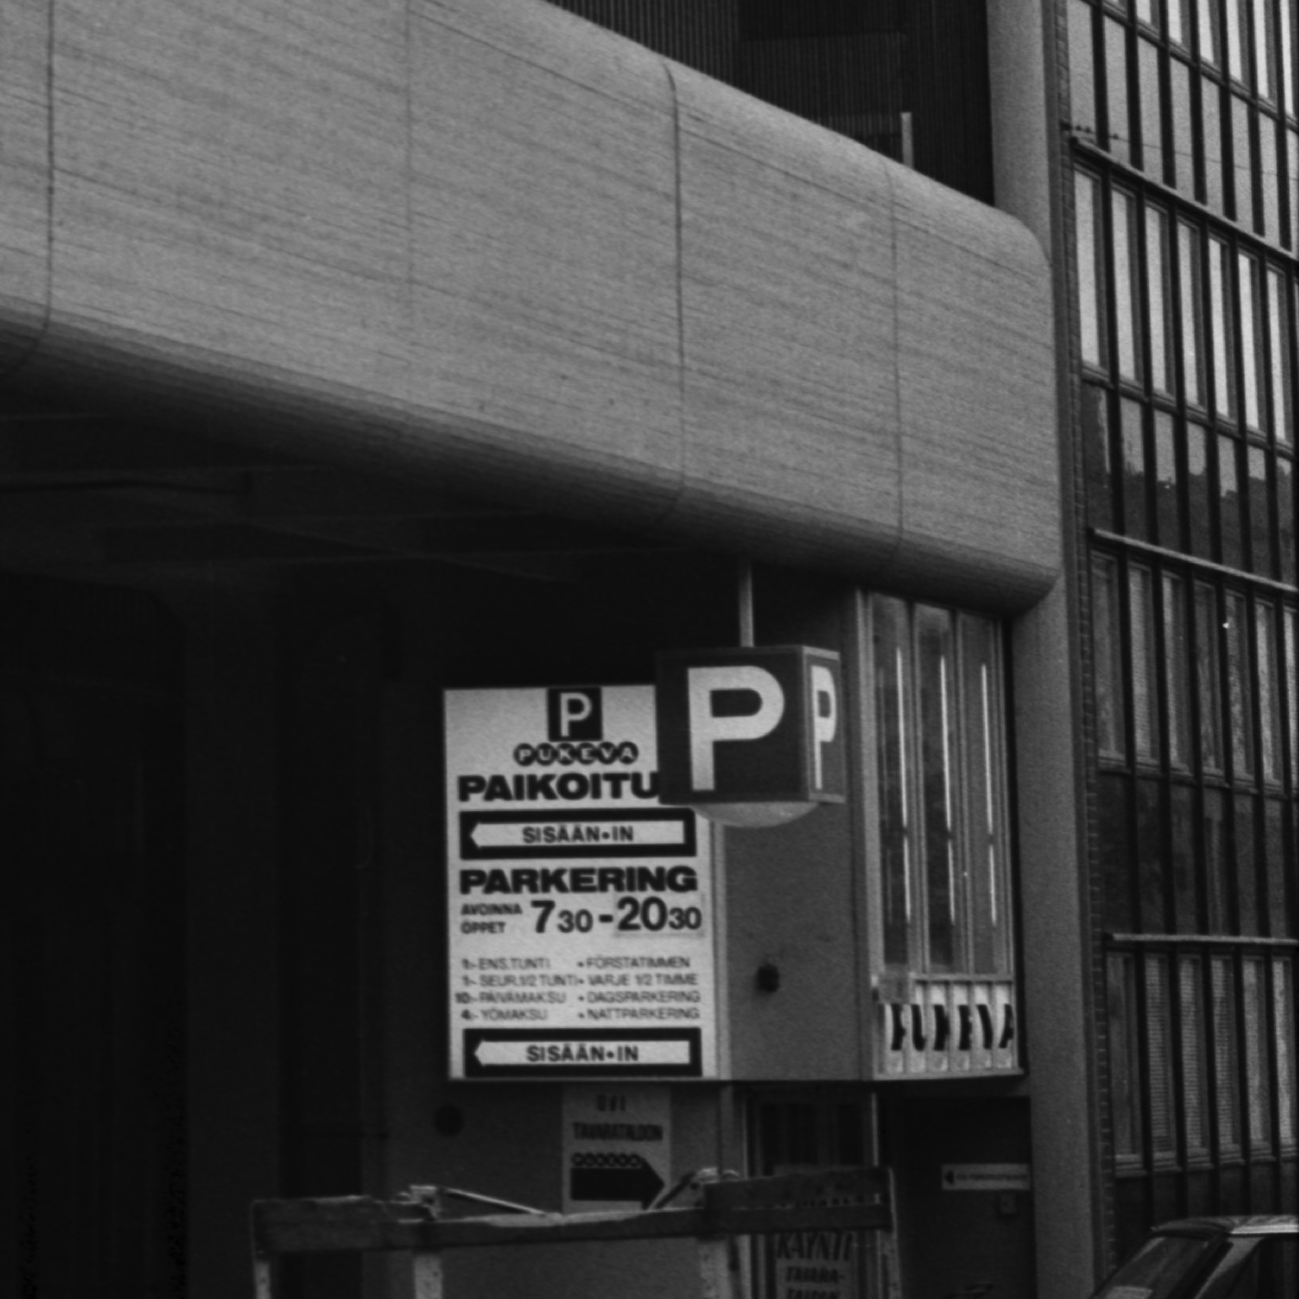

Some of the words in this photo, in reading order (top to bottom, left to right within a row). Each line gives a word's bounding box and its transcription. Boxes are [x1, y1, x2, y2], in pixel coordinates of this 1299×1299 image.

[559, 691, 593, 738] P
[688, 664, 785, 792] P
[810, 665, 838, 790] P
[514, 741, 639, 767] PUKEVA
[457, 771, 660, 802] PAIKOITU
[459, 866, 698, 895] PARKERING
[460, 903, 524, 916] AVOINNA
